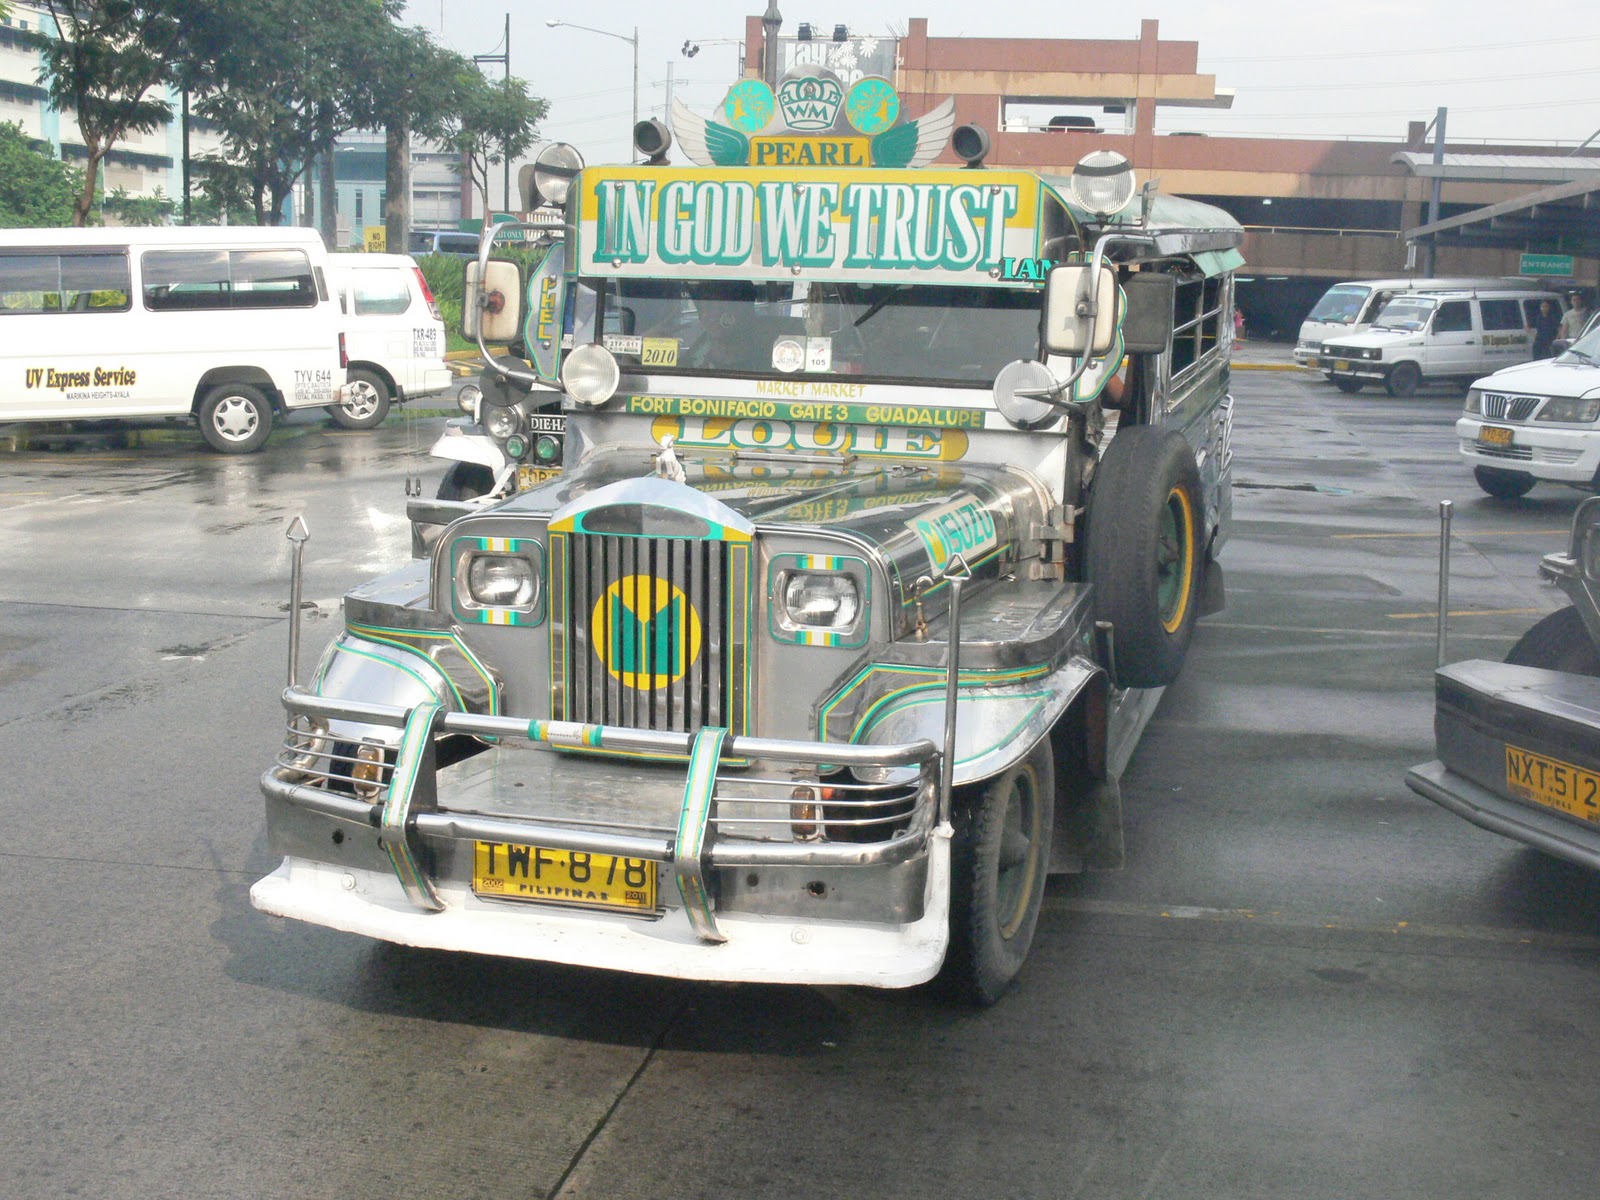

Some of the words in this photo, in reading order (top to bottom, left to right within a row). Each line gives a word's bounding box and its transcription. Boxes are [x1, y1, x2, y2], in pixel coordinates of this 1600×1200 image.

[756, 141, 866, 166] PEARL
[594, 179, 656, 264] IN
[659, 180, 757, 266] GOD
[757, 181, 838, 268] WE
[842, 182, 1019, 271] TRUST
[372, 232, 381, 241] NO
[368, 241, 386, 251] RIGHT
[1521, 261, 1571, 269] ENTRANCE
[643, 348, 676, 364] 2010
[25, 368, 44, 388] UV
[46, 368, 91, 392] Express
[93, 366, 136, 387] Service
[294, 370, 313, 383] TYV
[316, 369, 332, 383] 644
[66, 392, 91, 400] MARIKINA
[757, 380, 808, 396] MARKET
[811, 382, 867, 397] MARKET
[631, 396, 674, 414] FORT
[679, 399, 777, 418] BONIFACIO
[790, 403, 833, 421] GATE
[836, 404, 849, 422] 3
[866, 406, 982, 428] GUADALUPE
[676, 415, 942, 459] LOUIE
[933, 500, 994, 555] ISUZU
[519, 884, 610, 900] PILIPINAS
